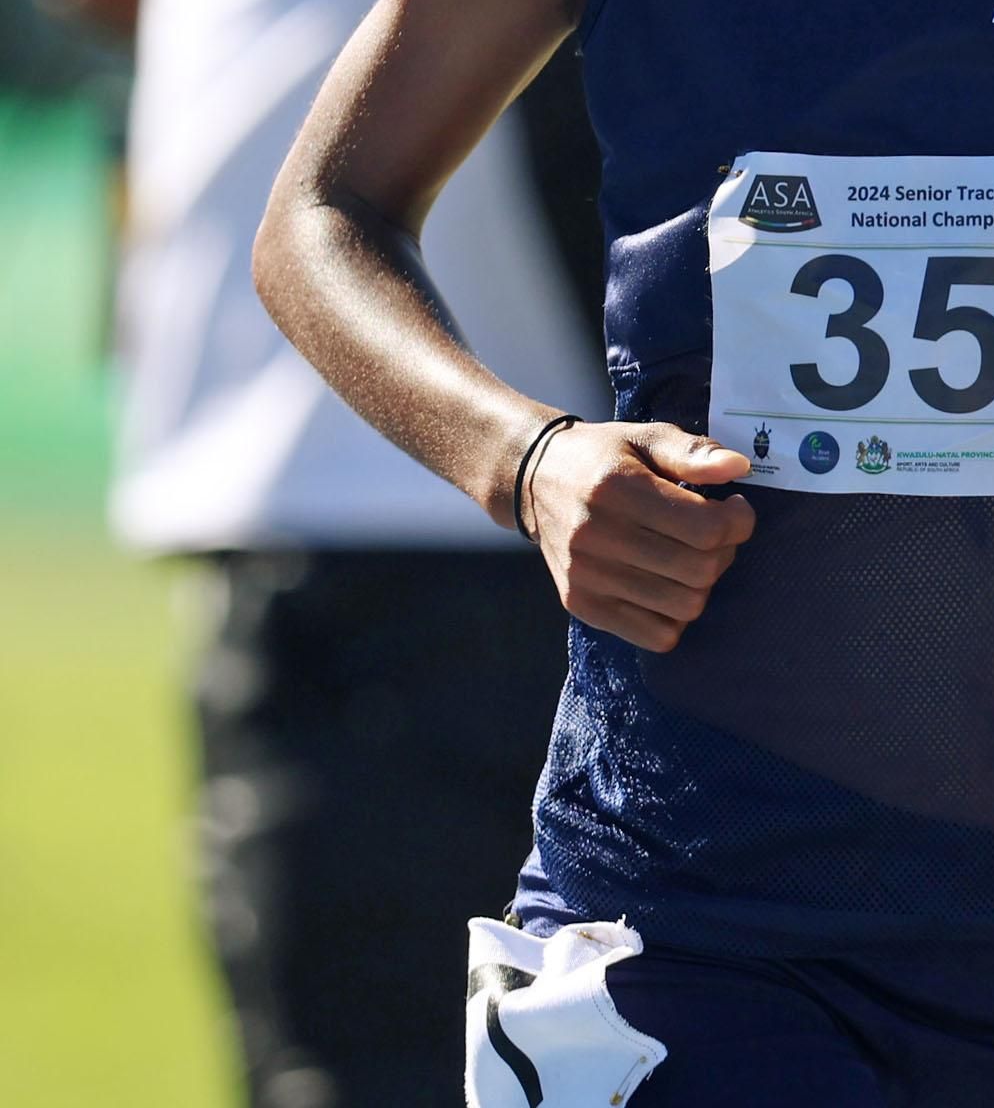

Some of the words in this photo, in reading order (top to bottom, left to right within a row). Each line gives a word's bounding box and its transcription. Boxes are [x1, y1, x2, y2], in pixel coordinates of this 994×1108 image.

[750, 181, 811, 208] ASA
[847, 186, 890, 201] 2024
[895, 185, 952, 201] Senior
[851, 211, 927, 228] National
[896, 451, 960, 459] KWAZULU-NATAL
